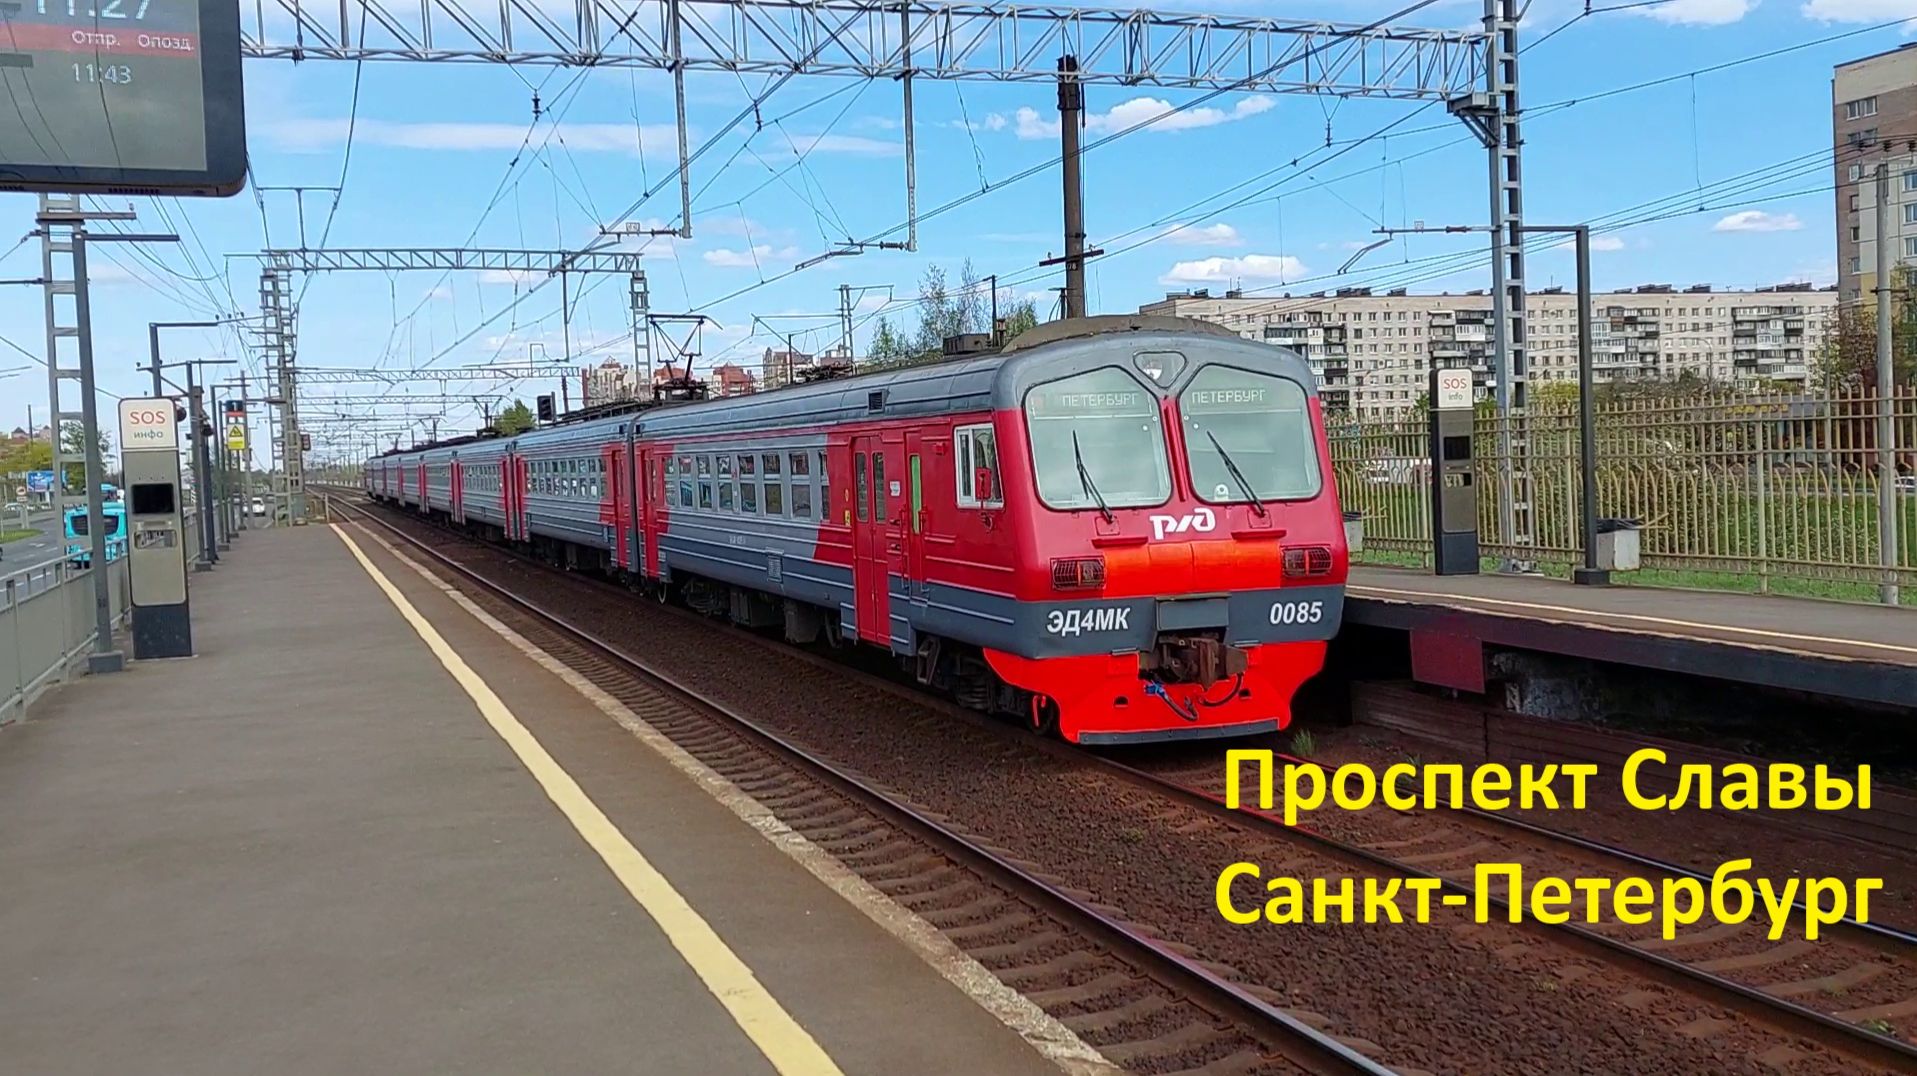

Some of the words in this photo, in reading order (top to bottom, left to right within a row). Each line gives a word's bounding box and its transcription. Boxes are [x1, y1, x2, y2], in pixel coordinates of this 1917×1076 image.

[71, 30, 120, 49] Отпр.
[138, 34, 194, 51] Опозд.
[71, 63, 132, 84] 11:43
[1443, 377, 1467, 390] SOS
[1062, 393, 1139, 407] ПЕТЕРБУРГ
[1191, 389, 1266, 404] ПЕТЕРБУРГ
[1448, 391, 1463, 401] info
[129, 410, 166, 425] SOS
[133, 429, 164, 440] инфо
[1269, 601, 1323, 625] 0085
[1046, 606, 1131, 637] ЭД4МК
